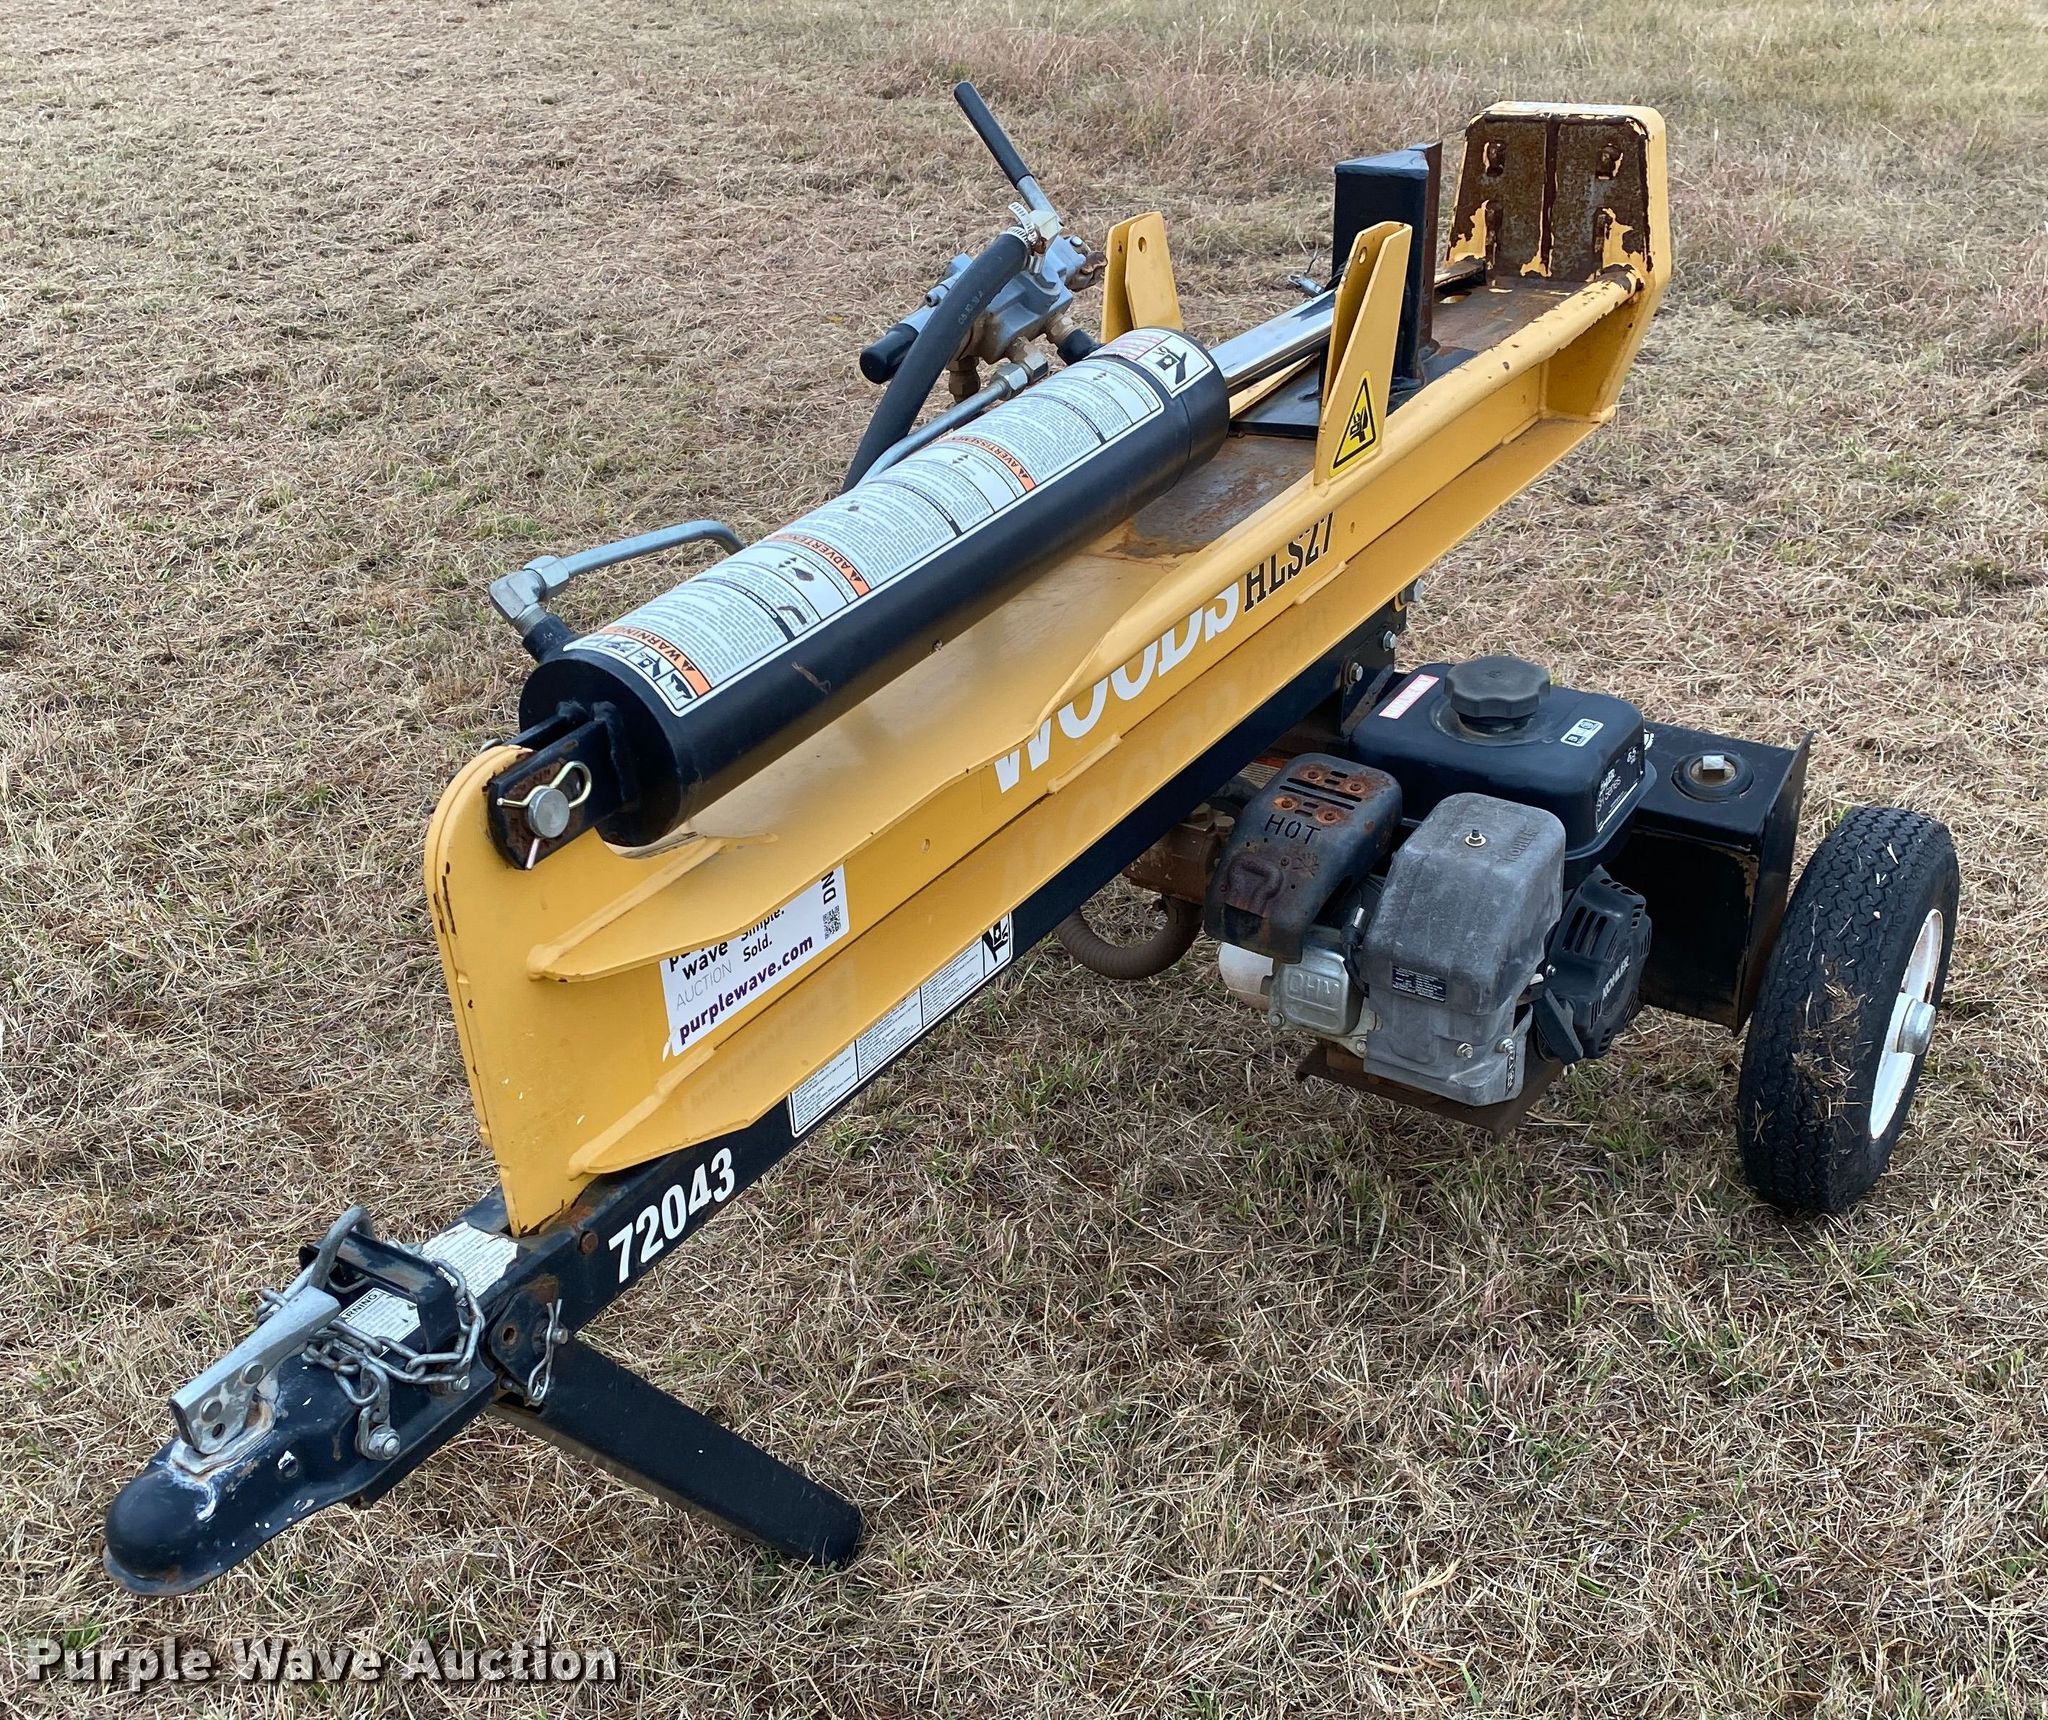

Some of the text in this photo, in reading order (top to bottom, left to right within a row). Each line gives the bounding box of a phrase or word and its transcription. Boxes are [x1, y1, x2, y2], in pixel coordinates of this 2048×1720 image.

[615, 626, 683, 661] WARNING
[1264, 813, 1321, 845] HOT
[682, 941, 729, 980] wave
[743, 932, 773, 963] Sold.
[677, 959, 733, 1010] AUCTION
[679, 936, 813, 1045] purplewave.com
[608, 1147, 735, 1284] 72043
